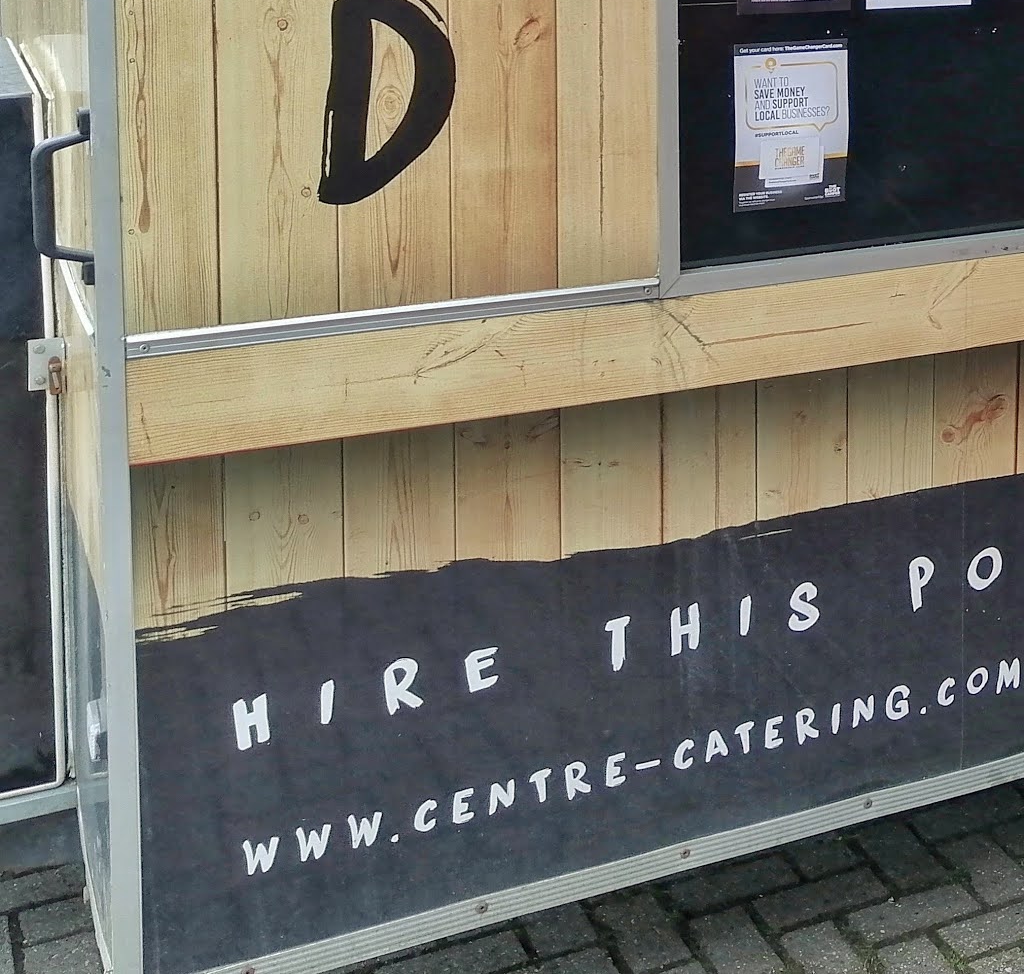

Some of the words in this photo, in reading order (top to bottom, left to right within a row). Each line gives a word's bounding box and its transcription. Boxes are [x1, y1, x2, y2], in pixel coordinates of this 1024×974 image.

[754, 77, 777, 88] WANT
[779, 76, 789, 87] TO
[754, 88, 774, 100] SAVE
[777, 86, 805, 98] MONEY
[754, 100, 771, 110] AND
[772, 97, 809, 109] SUPPORT
[755, 110, 780, 121] LOCAL
[782, 106, 830, 119] BUSINESSES?
[232, 646, 500, 751] HIRE
[604, 581, 820, 672] THIS
[242, 657, 1021, 875] WWW.CENTRE-CATERING.COM
